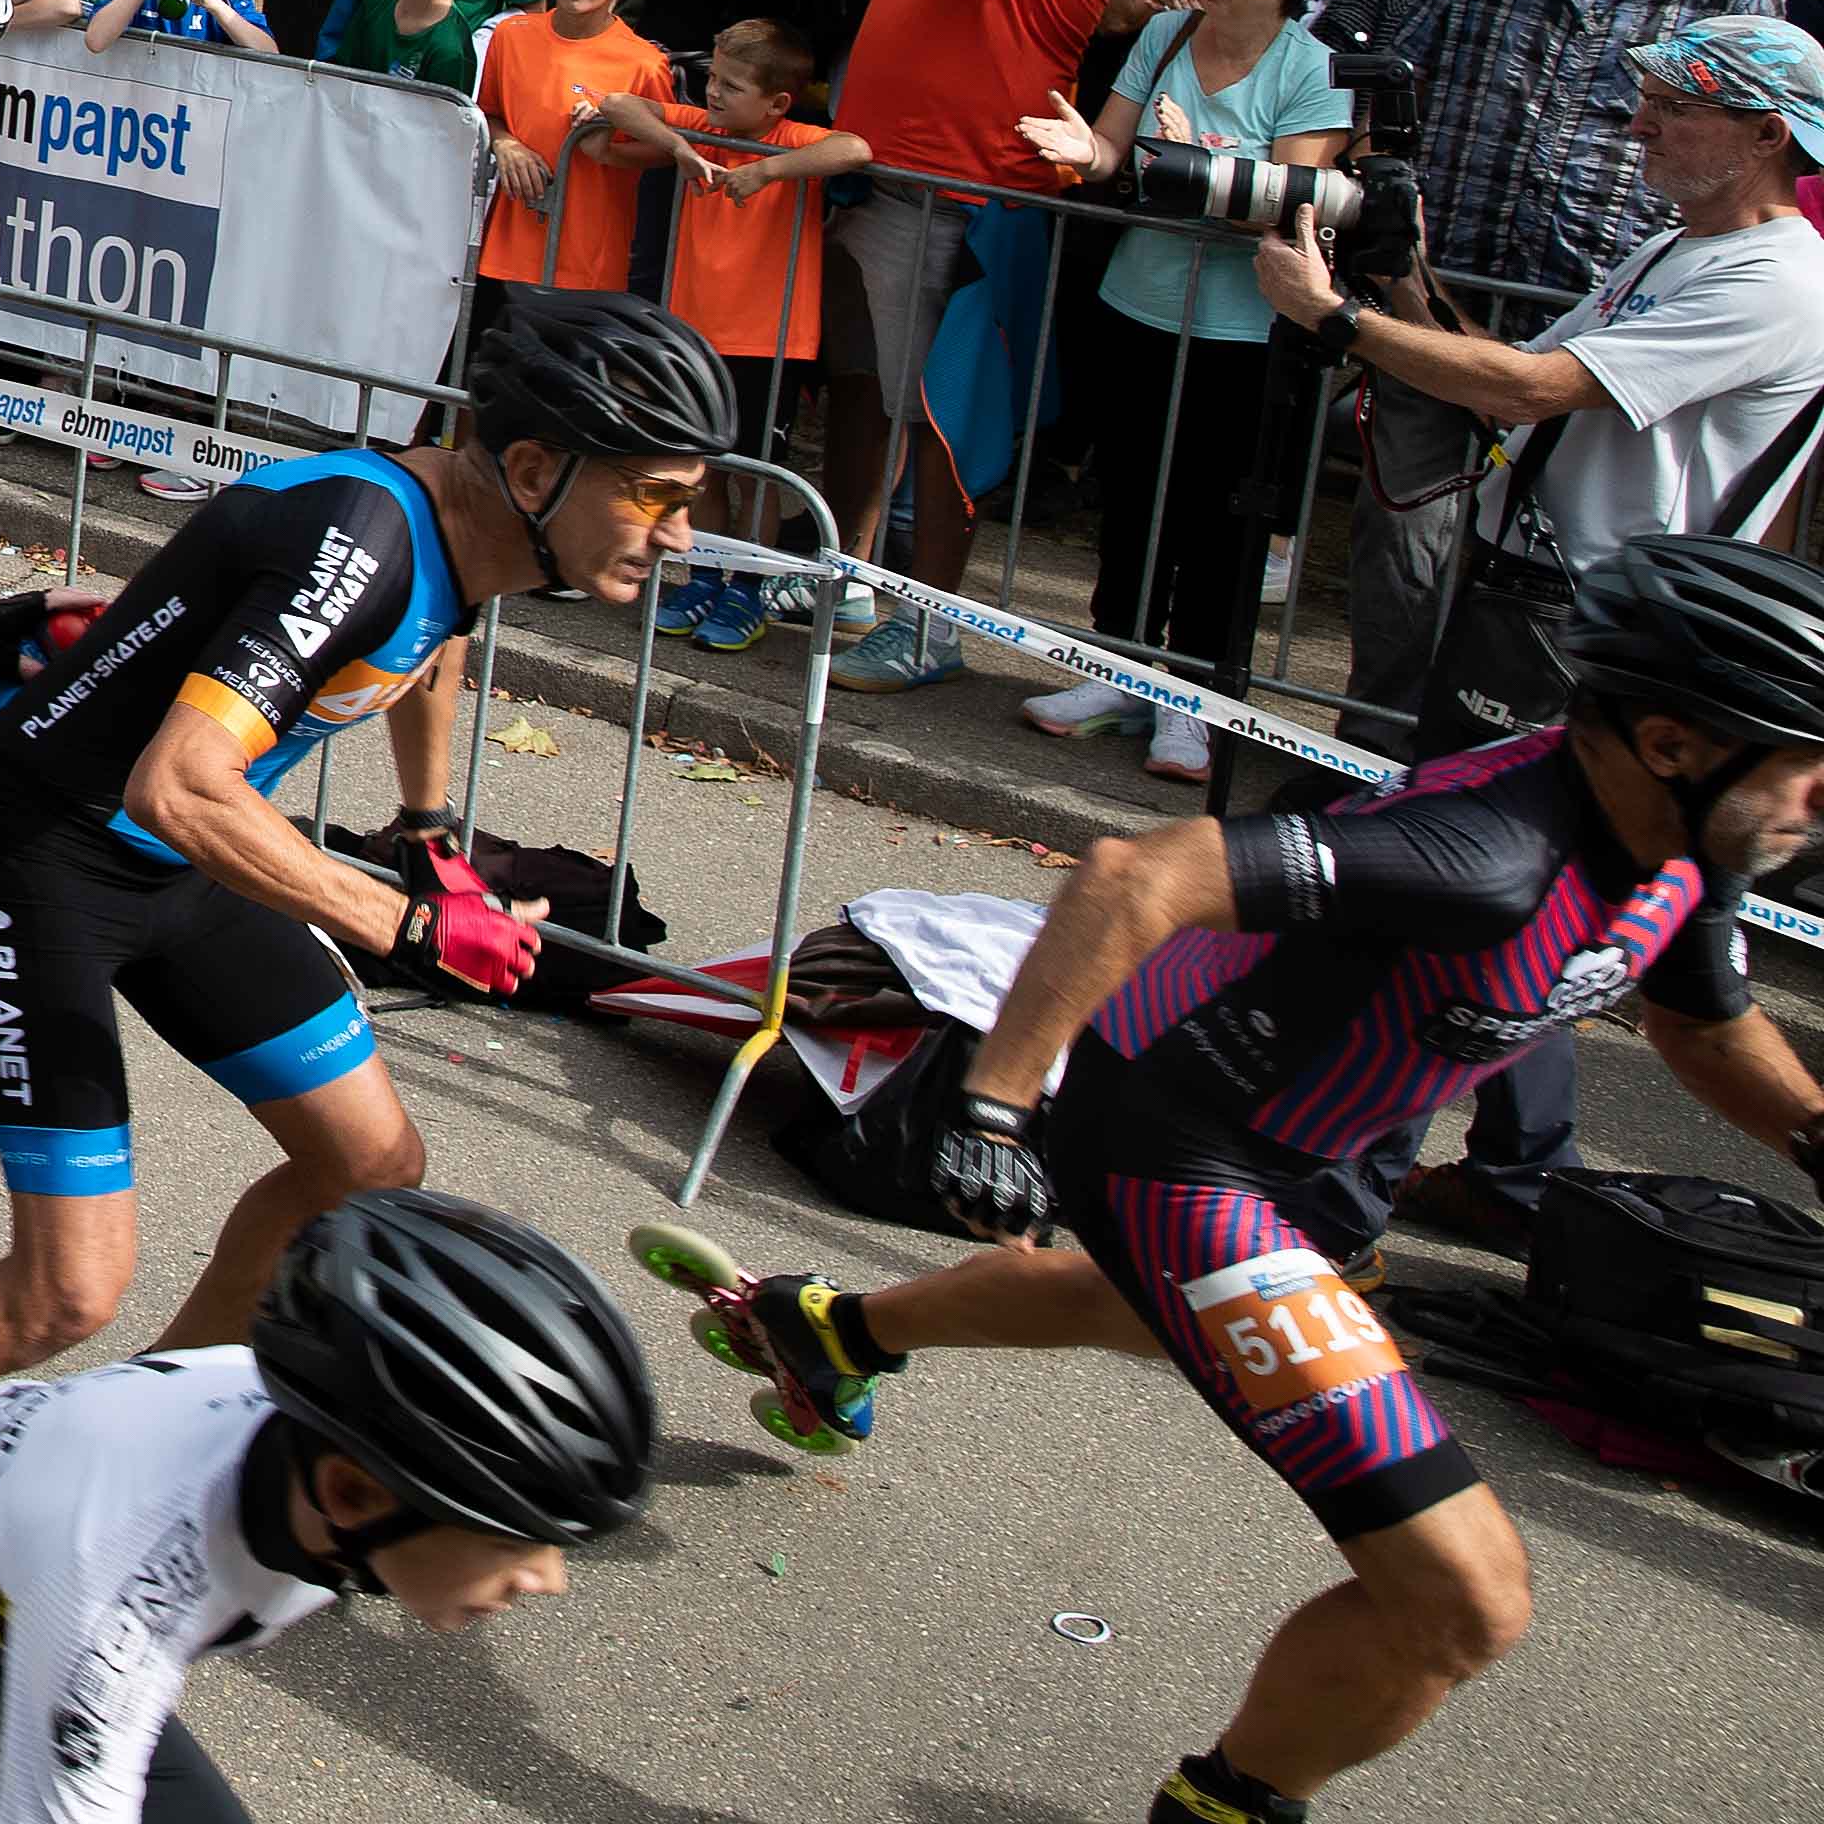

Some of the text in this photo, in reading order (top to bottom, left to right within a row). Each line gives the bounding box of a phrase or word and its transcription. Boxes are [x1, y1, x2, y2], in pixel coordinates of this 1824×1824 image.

[61, 404, 176, 457] ebmpapst
[293, 525, 356, 614] PLANET
[319, 546, 381, 629] SKATE
[20, 594, 188, 740] PLANET-SKATE.DE
[212, 664, 285, 727] MEISTER
[298, 1032, 351, 1065] HEMDEN
[1224, 1288, 1387, 1377] 5119
